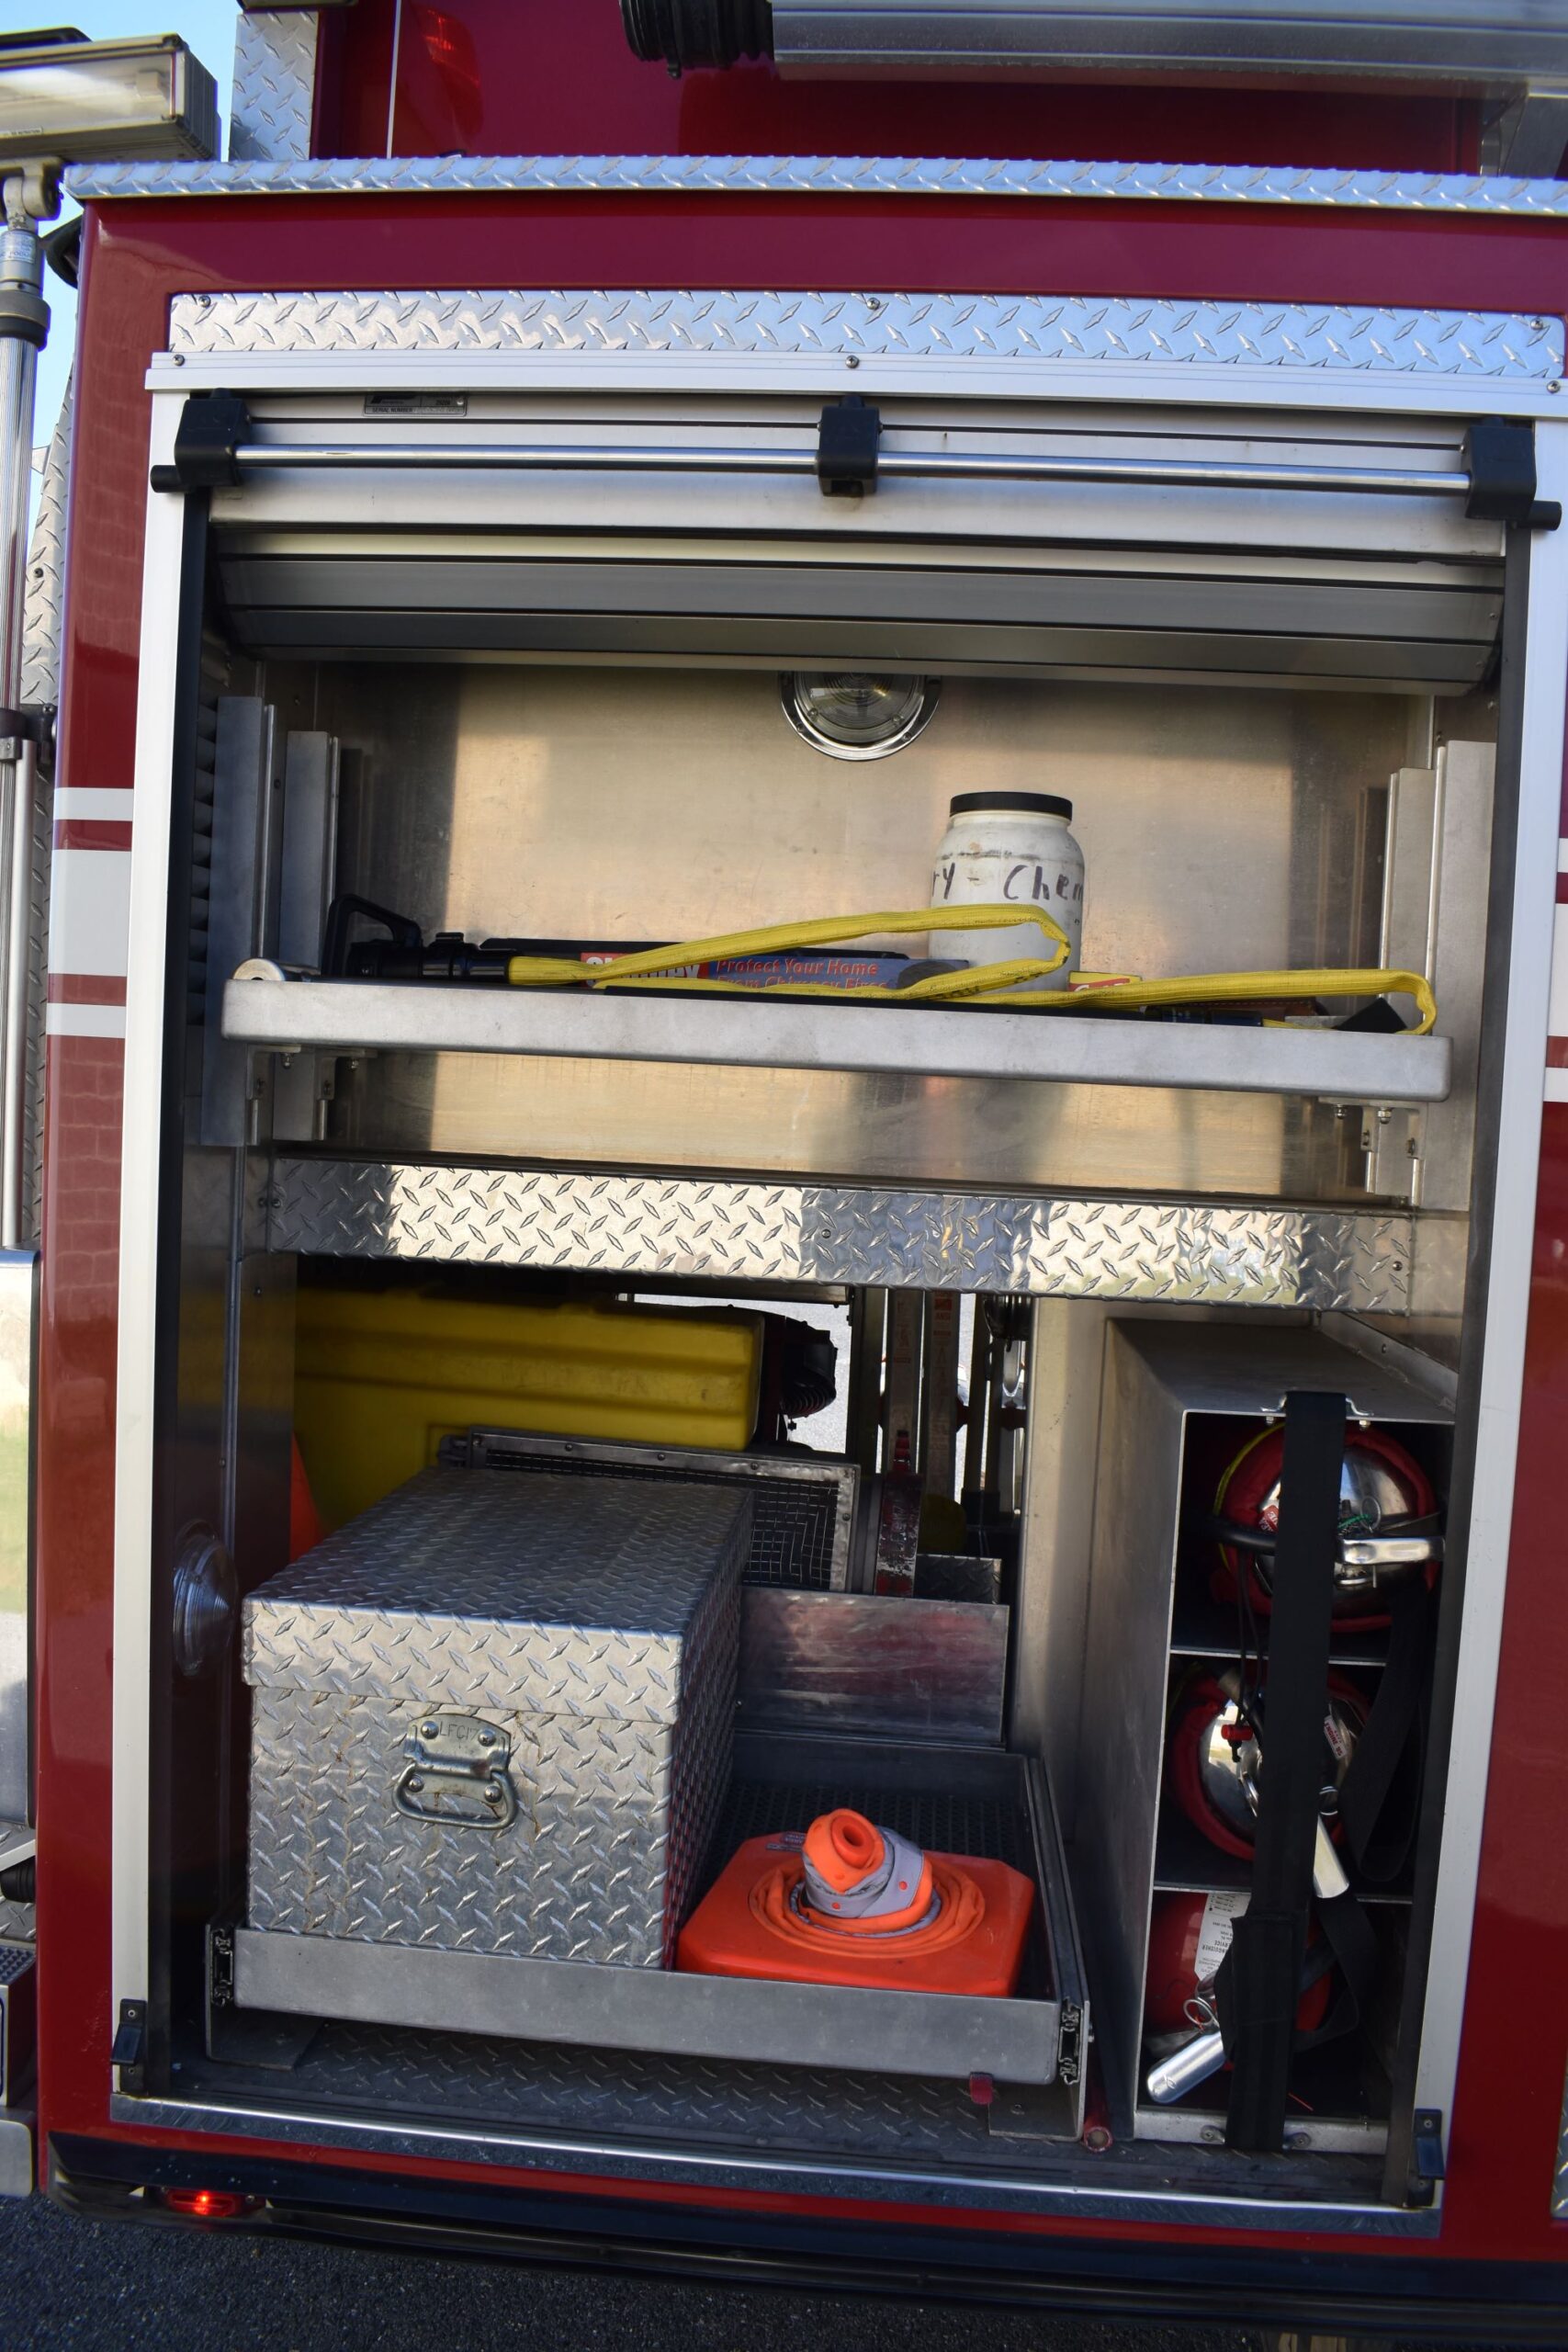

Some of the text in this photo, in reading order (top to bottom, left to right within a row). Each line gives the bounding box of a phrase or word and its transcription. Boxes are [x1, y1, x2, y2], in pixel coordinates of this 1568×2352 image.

[716, 958, 780, 974] Protect
[785, 958, 825, 975] Your
[827, 959, 879, 976] Home
